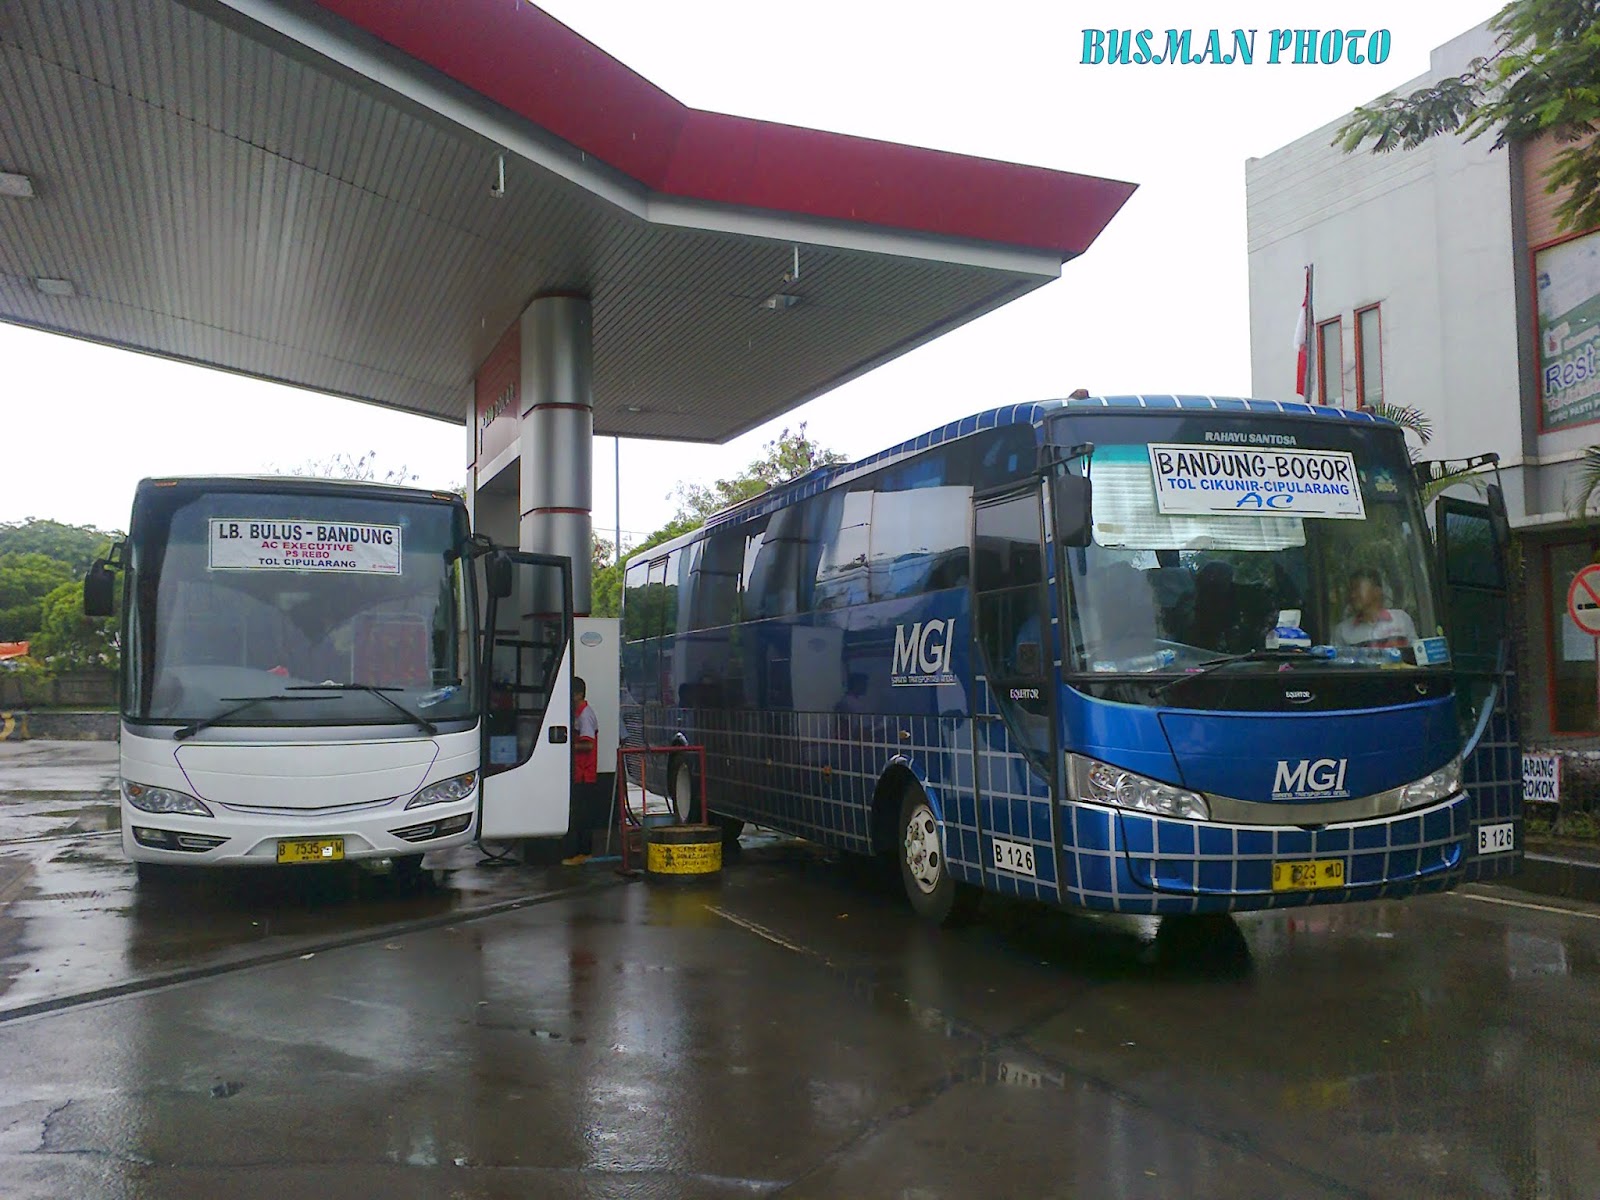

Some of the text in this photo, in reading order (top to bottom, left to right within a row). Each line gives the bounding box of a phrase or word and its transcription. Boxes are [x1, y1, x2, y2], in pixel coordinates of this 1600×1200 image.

[1545, 346, 1595, 395] Rest
[1205, 431, 1297, 446] RAHAYU SANTOSA
[1167, 478, 1196, 490] TOL
[1236, 491, 1294, 509] AC
[219, 523, 243, 539] LB.
[249, 524, 301, 541] BULUS
[317, 526, 393, 545] BANDUNG
[261, 541, 354, 552] AC EXECUTIVE
[301, 550, 330, 559] REBO
[258, 558, 356, 568] TOL CIPULARANG
[891, 618, 955, 675] MGI
[1272, 758, 1348, 793] MGI
[1480, 829, 1512, 849] B 126
[280, 844, 286, 856] B
[294, 842, 320, 855] 7535
[995, 844, 1033, 871] B 126
